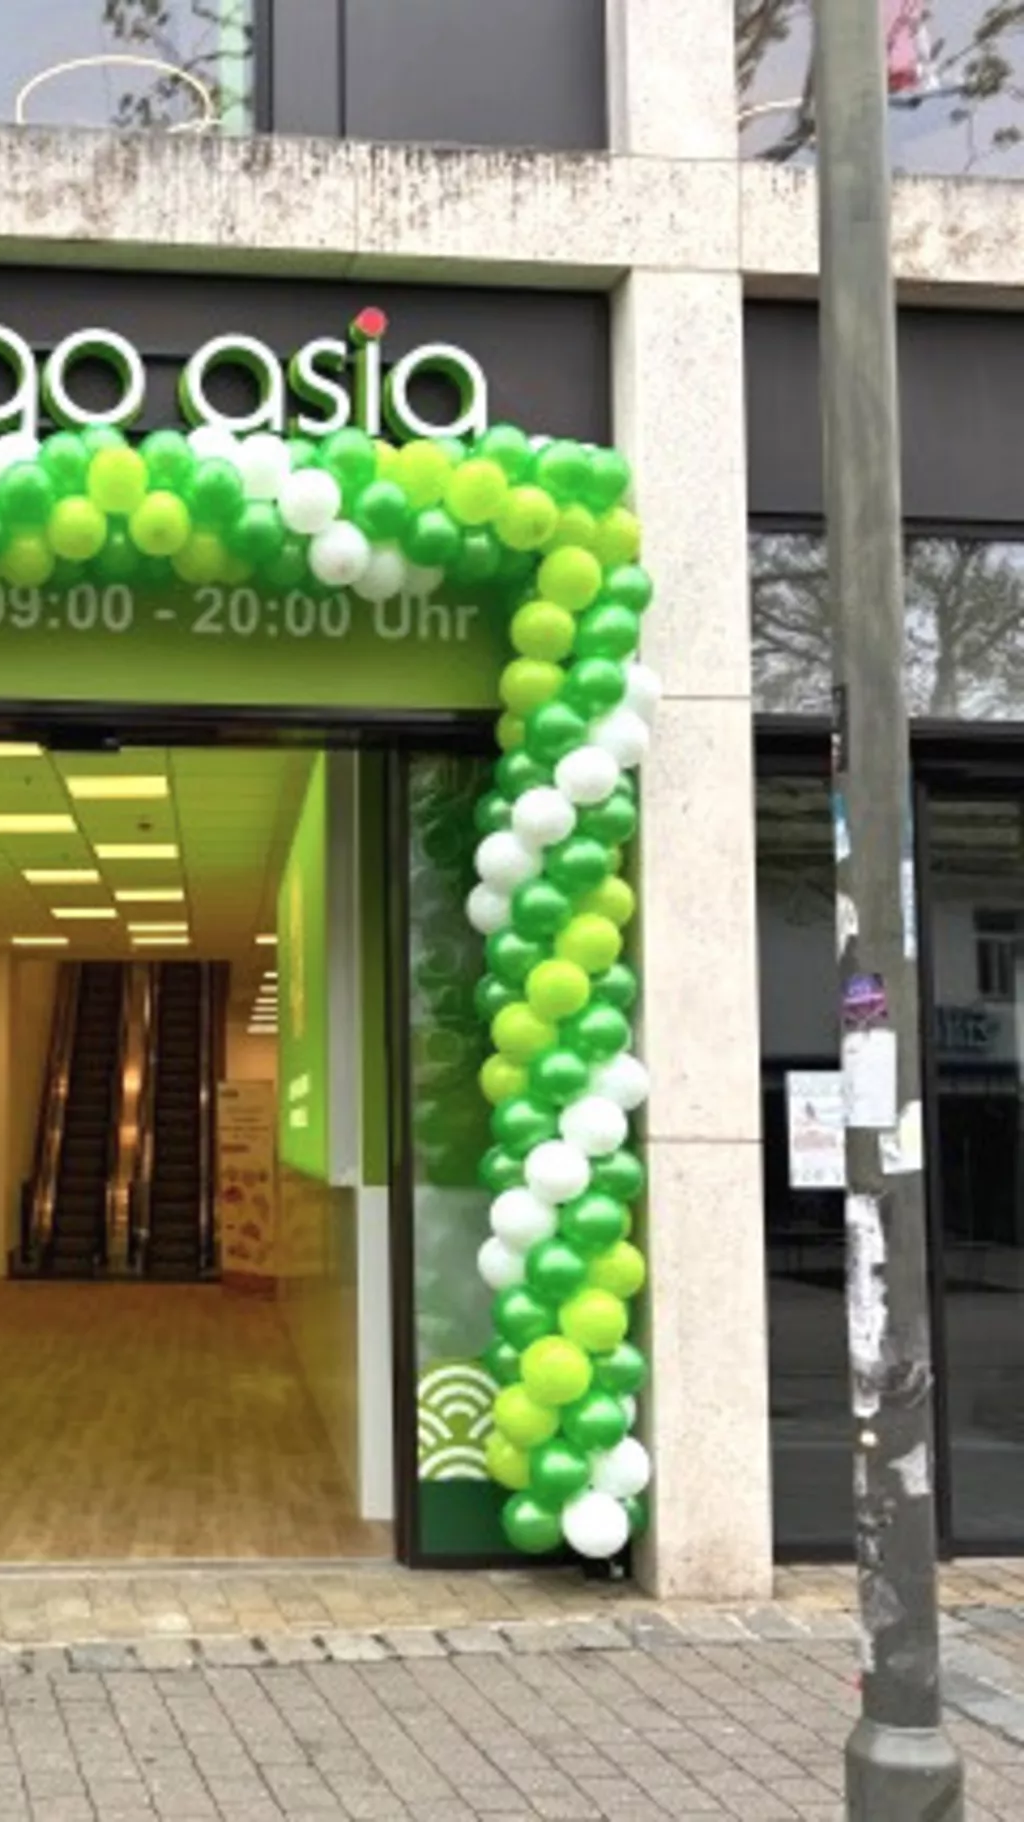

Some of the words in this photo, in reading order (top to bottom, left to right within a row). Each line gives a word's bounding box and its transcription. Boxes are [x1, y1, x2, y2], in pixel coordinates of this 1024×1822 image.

[182, 306, 489, 437] asia
[191, 587, 351, 638] 20:00
[374, 595, 479, 641] Uhr
